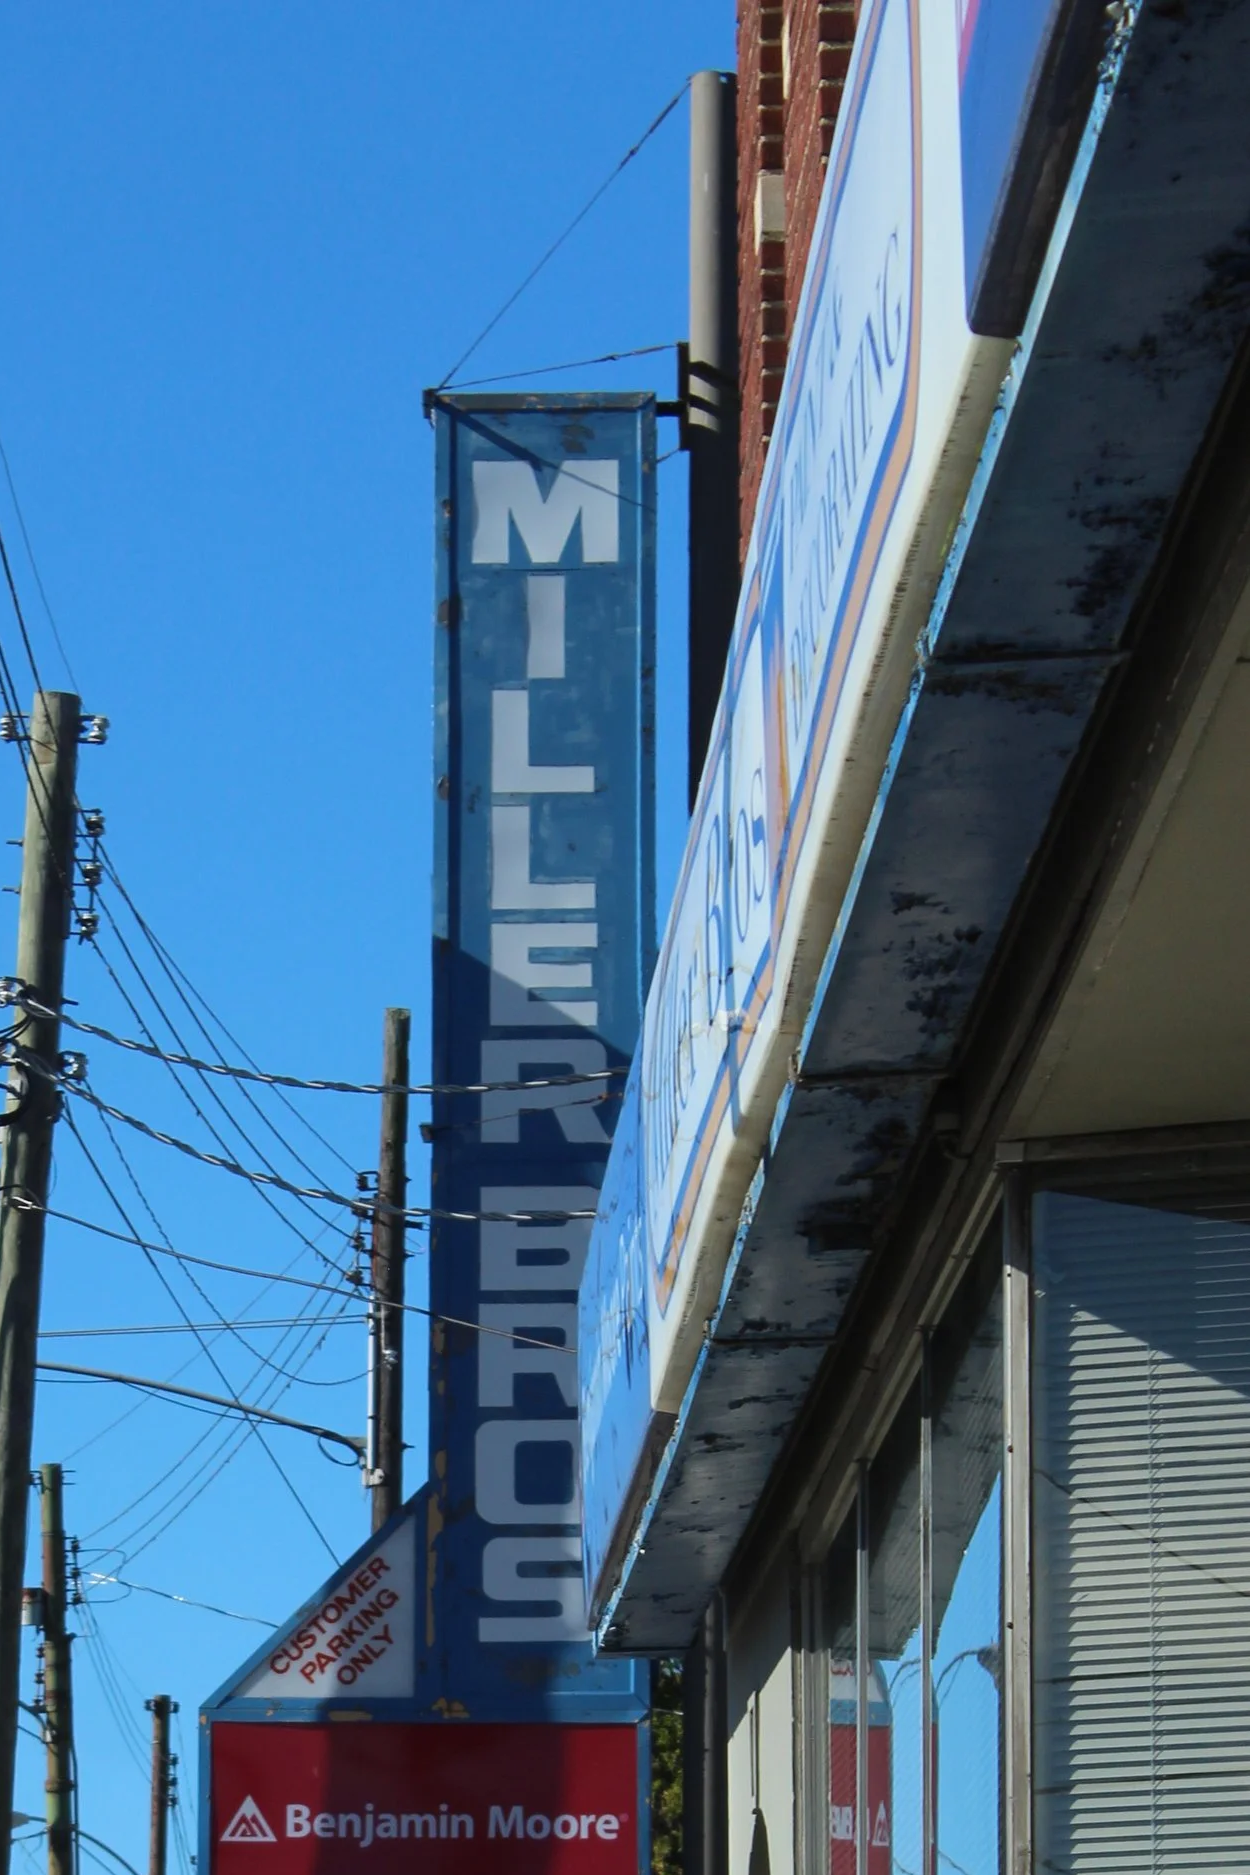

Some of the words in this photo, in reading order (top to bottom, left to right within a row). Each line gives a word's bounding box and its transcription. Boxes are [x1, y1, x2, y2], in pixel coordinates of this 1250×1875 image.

[791, 222, 902, 742] DECORATING
[471, 459, 619, 1143] MILLER
[706, 766, 766, 1027] Bos
[475, 1186, 593, 1642] BROS
[269, 1556, 391, 1674] CUSTOMER
[300, 1588, 399, 1684] PARKING
[337, 1624, 394, 1685] ONLY
[285, 1803, 474, 1848] Benjamin
[488, 1805, 620, 1840] Moore
